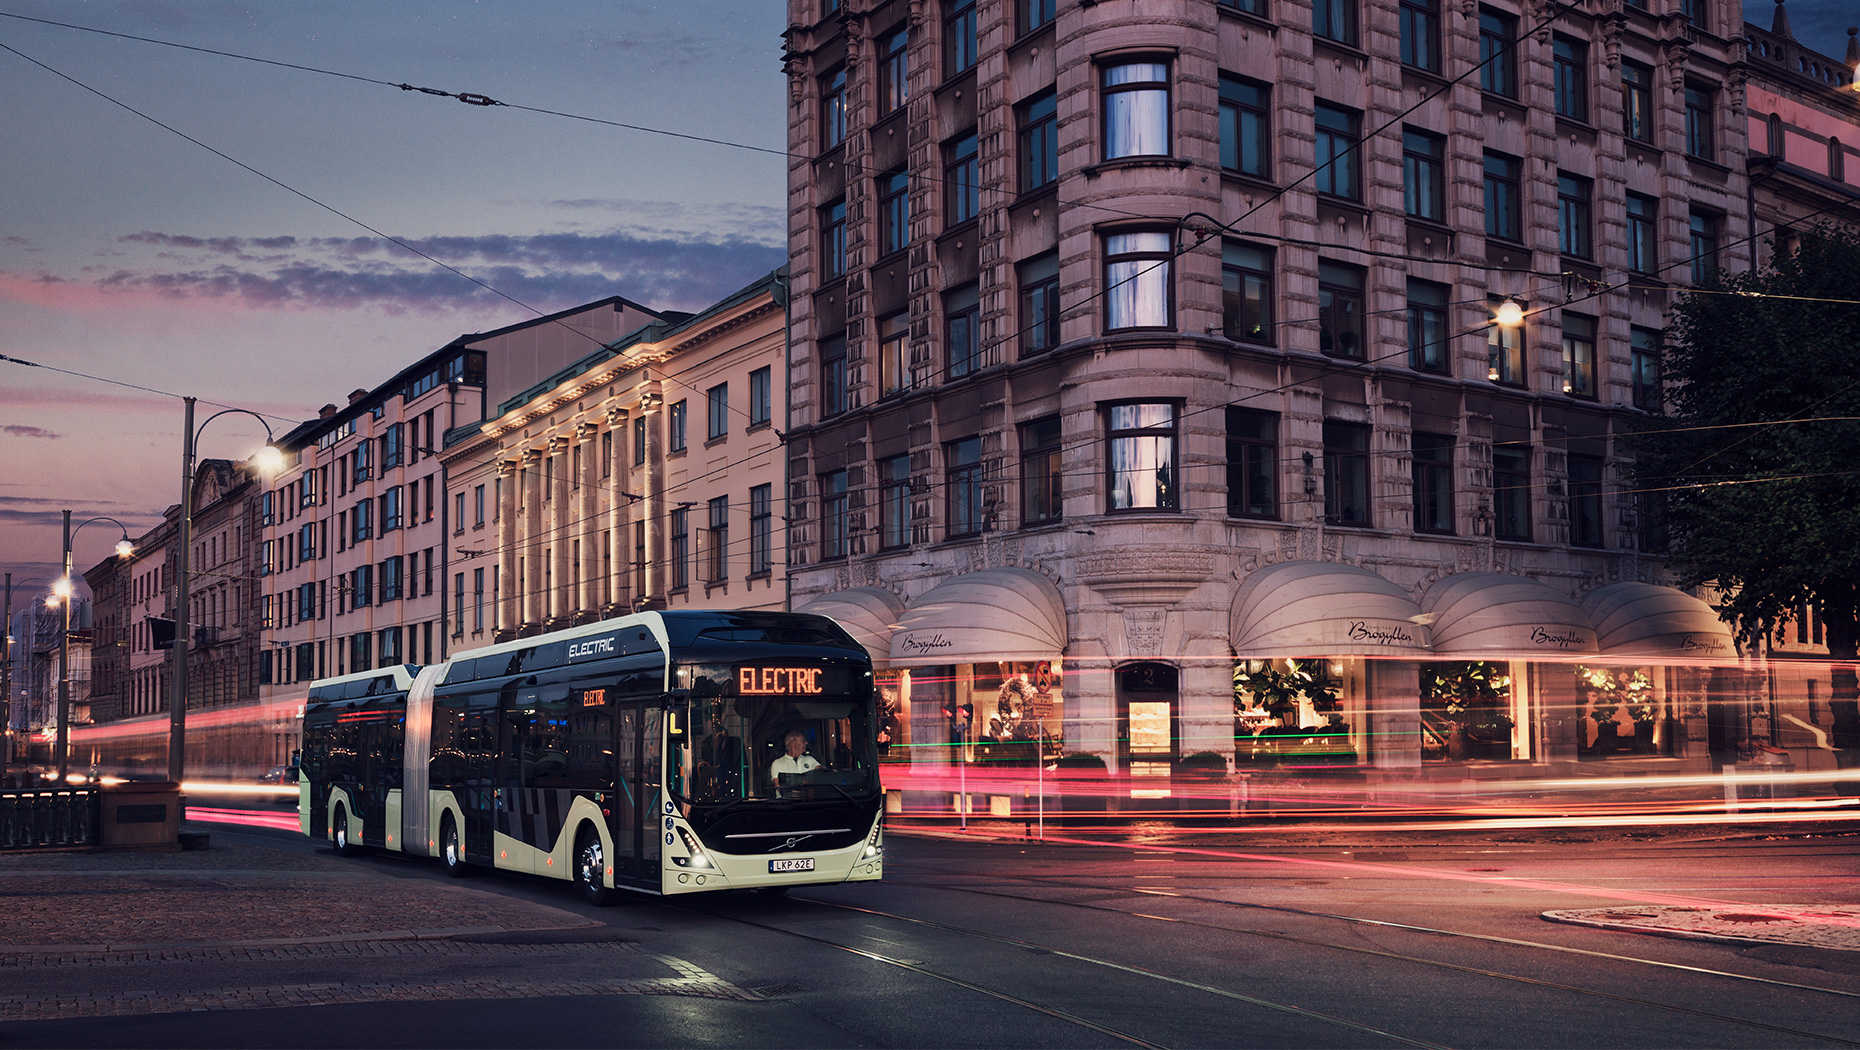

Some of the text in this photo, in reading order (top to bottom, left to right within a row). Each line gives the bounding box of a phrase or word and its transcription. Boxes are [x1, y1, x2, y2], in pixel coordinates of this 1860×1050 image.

[1348, 620, 1413, 645] Brogyllen
[1531, 626, 1585, 648] Brogyllen
[569, 637, 615, 658] ELECTRIC
[902, 633, 953, 654] Brogyllen
[740, 667, 823, 694] ELECTRIC
[1144, 667, 1154, 685] 2
[583, 689, 605, 707] ELECTRIC
[776, 859, 811, 870] LKP 62E
